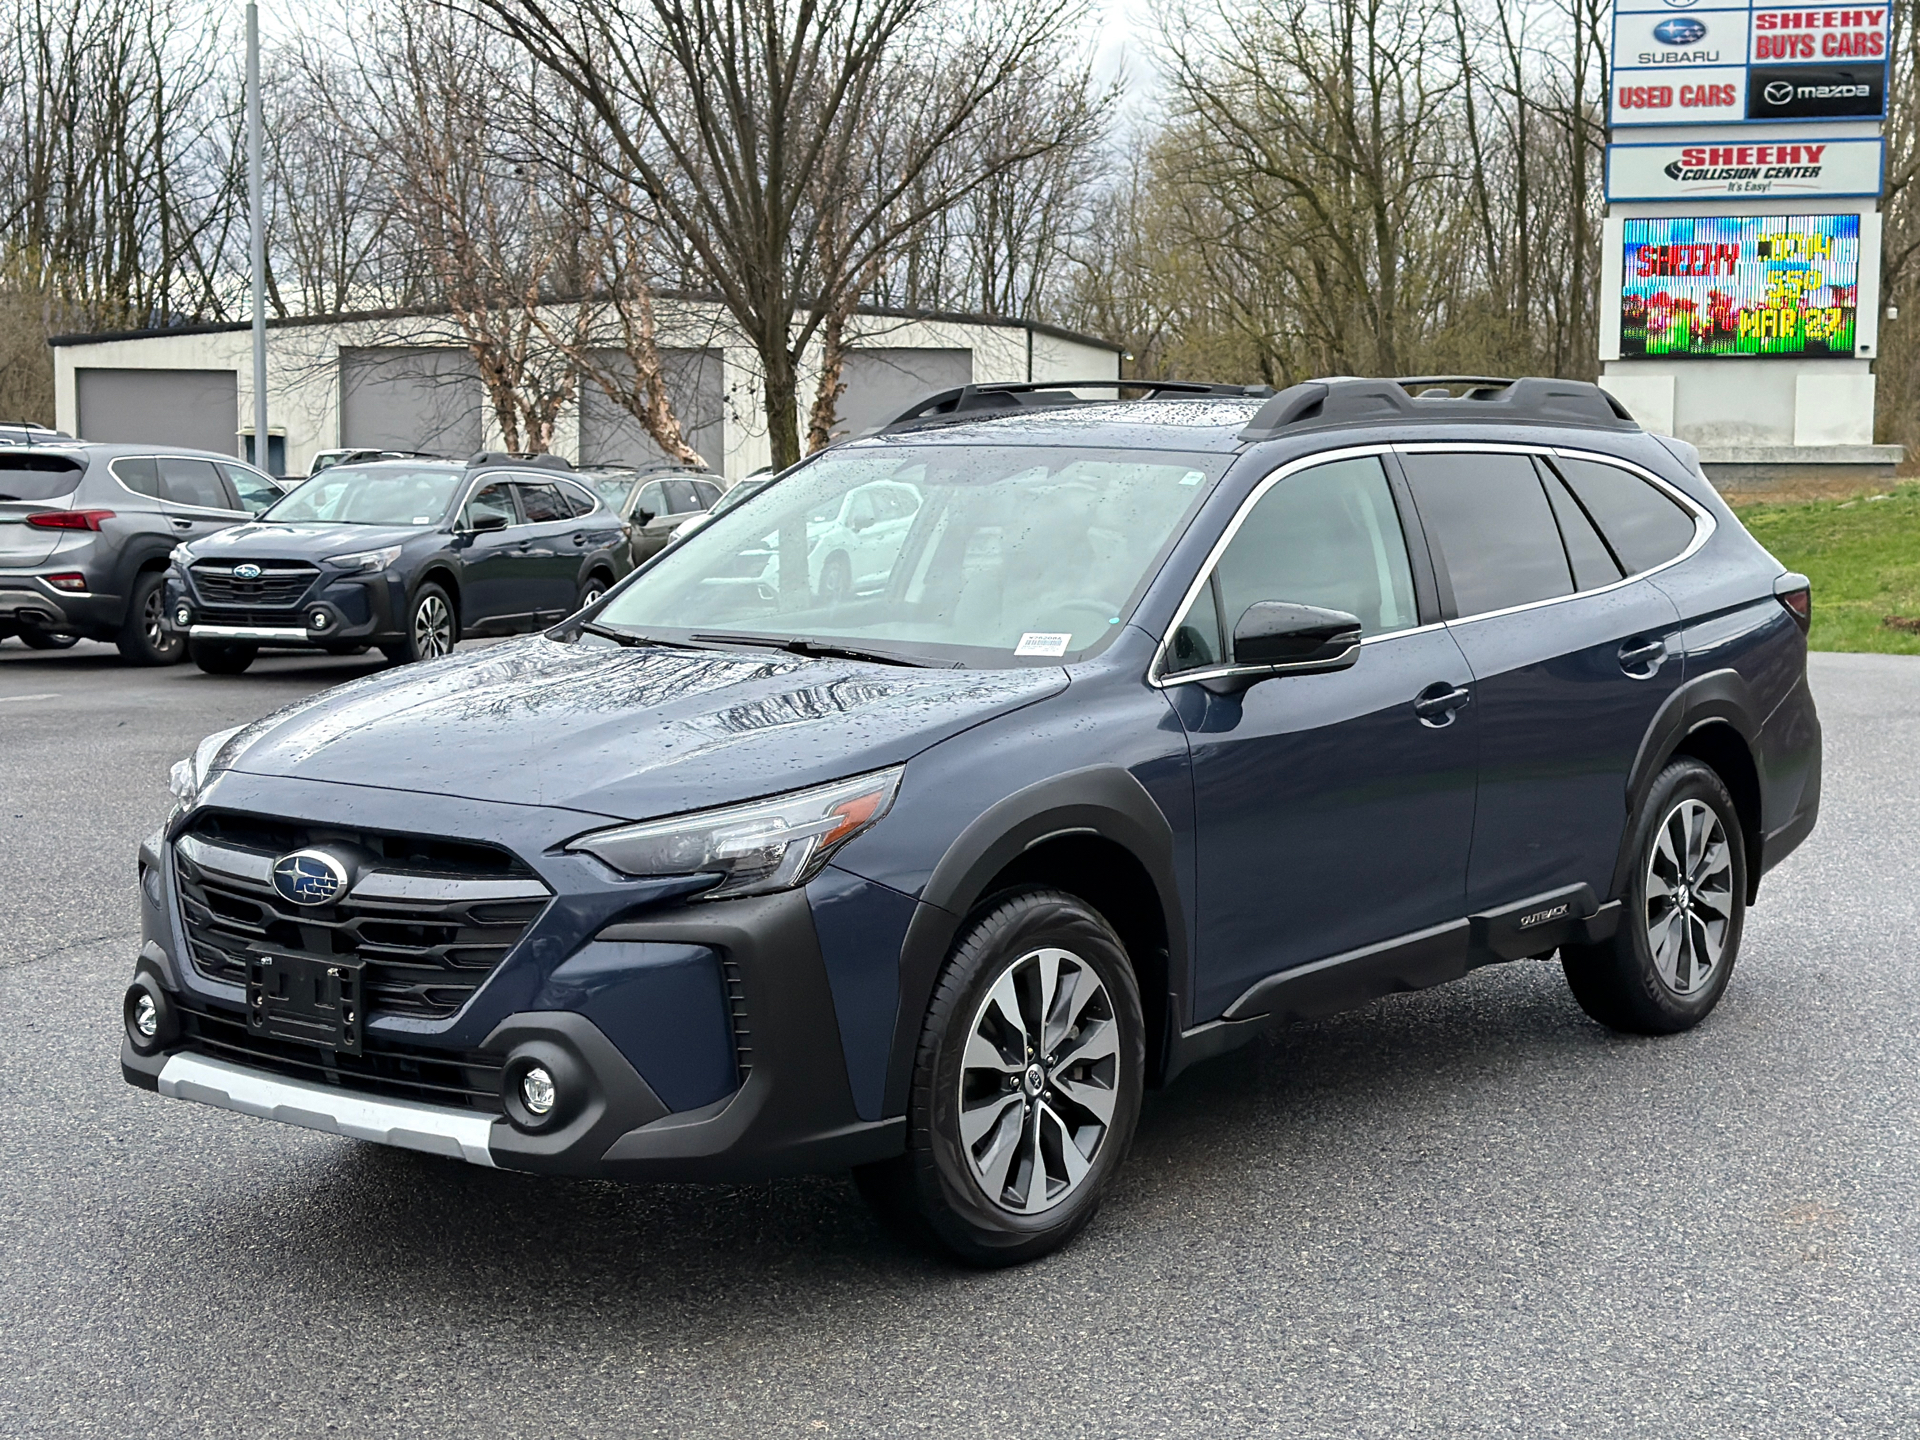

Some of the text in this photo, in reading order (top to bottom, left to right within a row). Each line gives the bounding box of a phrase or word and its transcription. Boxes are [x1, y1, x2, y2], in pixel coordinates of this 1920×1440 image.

[1756, 10, 1885, 30] SHEEHY
[1756, 31, 1885, 60] BUYS CARS
[1638, 51, 1720, 64] SUBARU
[1619, 84, 1736, 109] USED CARS
[1797, 84, 1870, 99] mazda
[1681, 145, 1826, 167] SHEEHY
[1681, 166, 1822, 181] COLLISION CENTER
[1727, 181, 1772, 193] It's Easy!
[1637, 243, 1740, 278] SHEEHY
[1739, 308, 1797, 338] MAR
[1520, 903, 1568, 926] OUTBACK
